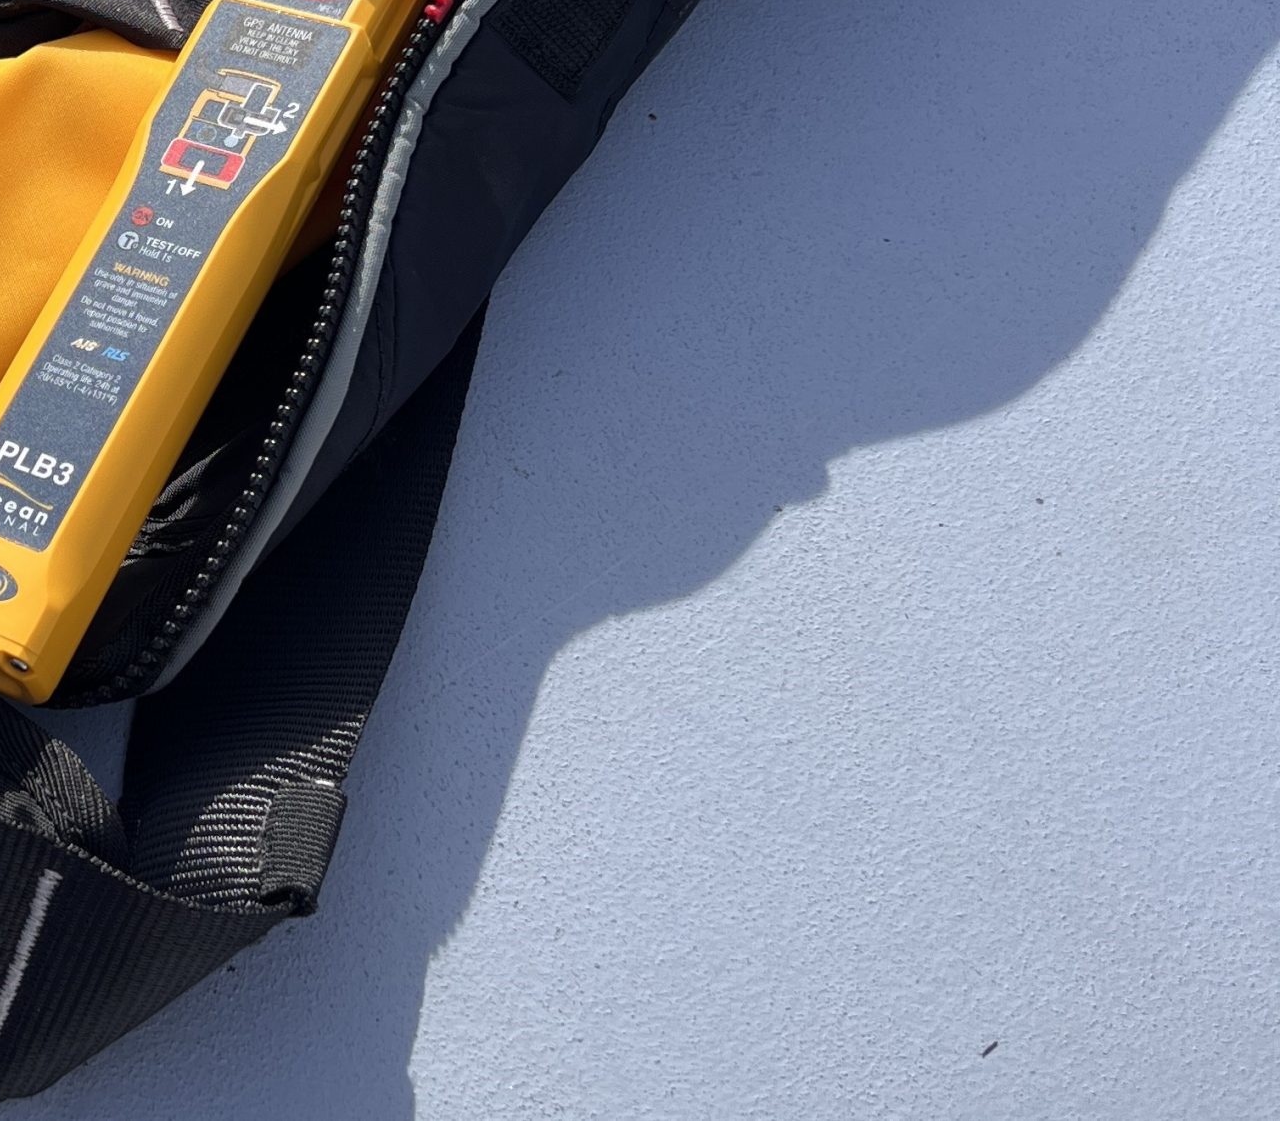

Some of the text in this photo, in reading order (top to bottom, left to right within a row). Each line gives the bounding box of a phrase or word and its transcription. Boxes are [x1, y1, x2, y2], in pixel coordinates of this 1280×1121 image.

[243, 17, 314, 41] GPS ANTENNA
[230, 43, 243, 53] DO
[243, 47, 260, 56] NOT
[239, 36, 257, 47] VIEW
[257, 40, 269, 49] OF
[282, 46, 299, 56] SKY
[283, 102, 300, 119] 2
[165, 179, 177, 195] 1
[156, 217, 174, 229] ON
[138, 246, 161, 259] Hold
[146, 236, 201, 259] TEST/OFF
[113, 262, 170, 287] WARNING
[80, 295, 93, 305] Do
[92, 301, 107, 310] not
[106, 305, 128, 317] move
[83, 308, 107, 321] report
[70, 338, 130, 362] AIS RLS
[42, 362, 80, 381] Operating
[52, 354, 121, 383] Class 2 Category 2
